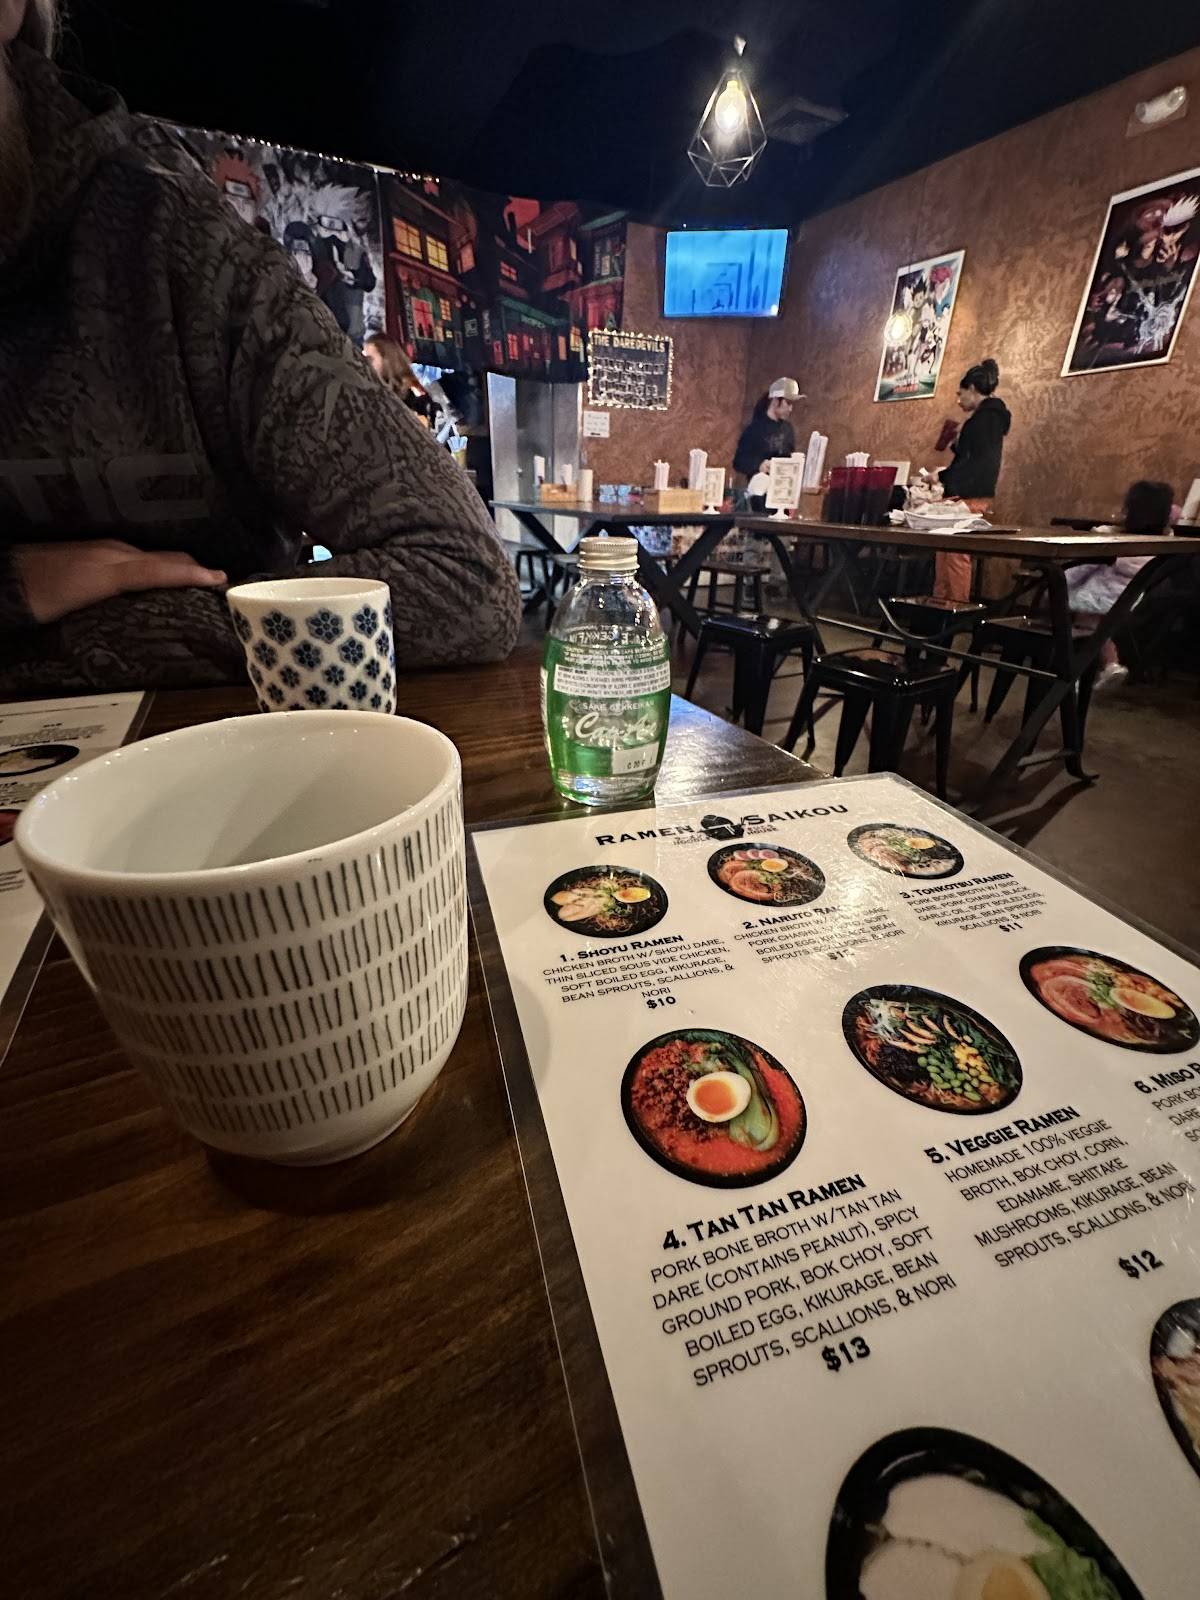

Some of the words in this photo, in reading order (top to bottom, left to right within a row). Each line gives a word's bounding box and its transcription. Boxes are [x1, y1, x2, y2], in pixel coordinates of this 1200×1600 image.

[593, 334, 610, 347] THE
[595, 825, 695, 846] RAMEN
[743, 805, 848, 825] SAIKOU
[899, 891, 915, 899] 3.
[911, 880, 974, 896] TONKOTSU
[971, 873, 1014, 885] RAMEN
[906, 898, 933, 907] PORK
[932, 893, 958, 902] BONE
[956, 887, 986, 897] BROTH
[941, 899, 966, 908] PORK
[1001, 886, 1031, 896] BLACK
[969, 902, 993, 911] SOFT
[991, 896, 1024, 906] BOILED
[980, 908, 1007, 918] BEAN
[1019, 909, 1042, 918] NORI
[733, 927, 779, 941] CHICKEN
[779, 921, 812, 932] BROTH
[742, 921, 759, 930] 2.
[758, 911, 813, 927] NARUTO
[999, 922, 1024, 933] $11
[560, 954, 576, 963] 1.
[577, 944, 628, 959] SHOYU
[630, 934, 684, 950] RAMEN
[748, 937, 778, 948] PORK
[756, 943, 794, 955] BOILED
[869, 921, 897, 932] BEAN
[543, 962, 594, 976] CHICKEN
[596, 954, 635, 966] BROTH
[544, 974, 574, 984] THIN
[576, 967, 617, 980] SLICED
[619, 960, 651, 972] SOUS
[652, 955, 678, 965] VIDE
[561, 981, 593, 992] SOFT
[595, 973, 638, 986] BOILED
[561, 991, 595, 1003] BEAN
[724, 963, 735, 971] &
[641, 987, 671, 998] NORI
[646, 996, 676, 1009] $10
[1134, 1080, 1158, 1094] 6.
[1149, 1068, 1195, 1089] MISO
[1151, 1092, 1189, 1111] PORK
[924, 1147, 950, 1164] 5.
[945, 1126, 1020, 1157] VEGGIE
[1012, 1105, 1081, 1135] RAMEN
[944, 1148, 1025, 1183] HOMEMADE
[1022, 1134, 1067, 1158] 100%
[1061, 1119, 1112, 1143] VEGGIE
[959, 1174, 1017, 1202] BROTH,
[1014, 1164, 1046, 1184] BOK
[1043, 1150, 1089, 1171] CHOY,
[973, 1203, 1076, 1248] MUSHROOMS,
[1071, 1176, 1145, 1211] KIKURAGE,
[1140, 1161, 1179, 1181] BEAN
[996, 1179, 1073, 1213] EDAMAME,
[662, 1229, 687, 1251] 4.
[687, 1209, 741, 1244] TAN
[737, 1199, 789, 1226] TAN
[786, 1174, 867, 1211] RAMEN
[994, 1231, 1072, 1268] SPROUTS,
[1066, 1199, 1152, 1239] SCALLIONS,
[1149, 1191, 1164, 1207] &
[1158, 1180, 1197, 1202] NORI
[650, 1254, 702, 1284] PORK
[702, 1237, 755, 1267] BONE
[753, 1218, 811, 1250] BROTH
[867, 1188, 903, 1208] TAN
[652, 1279, 704, 1310] DARE
[704, 1252, 801, 1293] (CONTAINS
[800, 1221, 876, 1258] PEANUT),
[874, 1205, 920, 1232] SPICY
[1118, 1249, 1165, 1280] $12
[661, 1296, 745, 1336] GROUND
[744, 1278, 801, 1306] PORK,
[800, 1261, 843, 1286] BOK
[839, 1243, 893, 1271] CHOY,
[890, 1227, 935, 1252] SOFT
[684, 1319, 756, 1358] BOILED
[756, 1304, 804, 1331] EGG,
[802, 1269, 896, 1313] KIKURAGE,
[892, 1251, 940, 1279] BEAN
[692, 1338, 791, 1388] SPROUTS,
[790, 1297, 898, 1350] SCALLIONS,
[896, 1288, 915, 1308] &
[912, 1272, 957, 1302] NORI
[821, 1335, 871, 1372] $13
